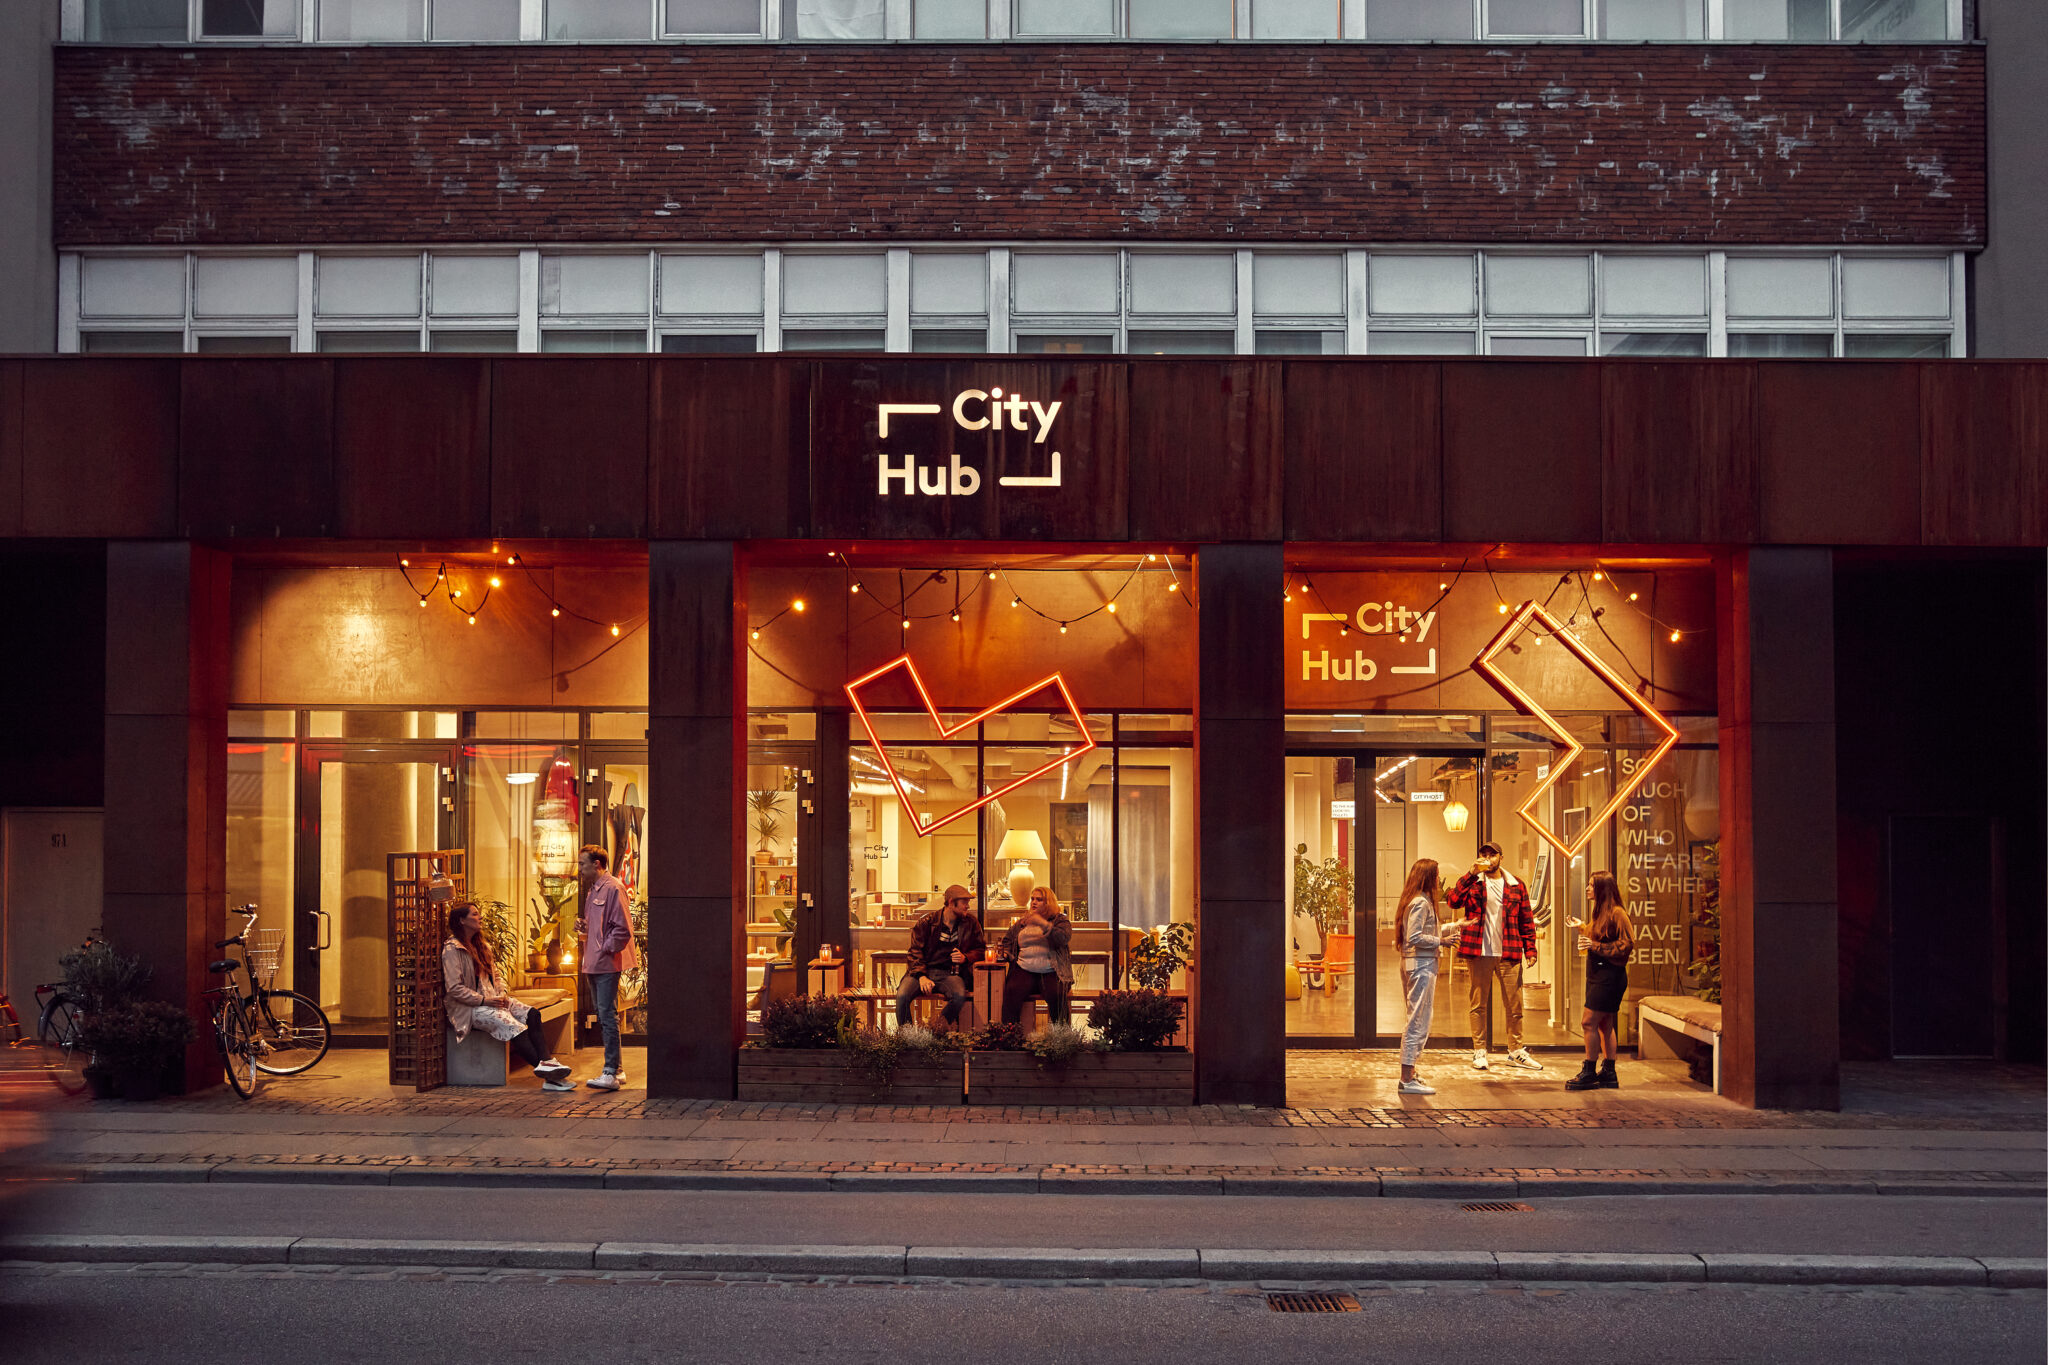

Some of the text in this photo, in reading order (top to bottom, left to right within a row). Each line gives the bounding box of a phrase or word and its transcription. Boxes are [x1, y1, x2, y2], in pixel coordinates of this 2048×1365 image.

[953, 387, 1062, 443] City
[879, 454, 981, 496] Hub
[1356, 601, 1436, 642] City
[1302, 650, 1377, 681] Hub
[1622, 805, 1651, 822] OF
[1623, 829, 1674, 846] WHO
[873, 844, 888, 852] City
[1626, 853, 1702, 870] WE ARE
[1628, 876, 1640, 893] S
[1628, 900, 1656, 917] WE
